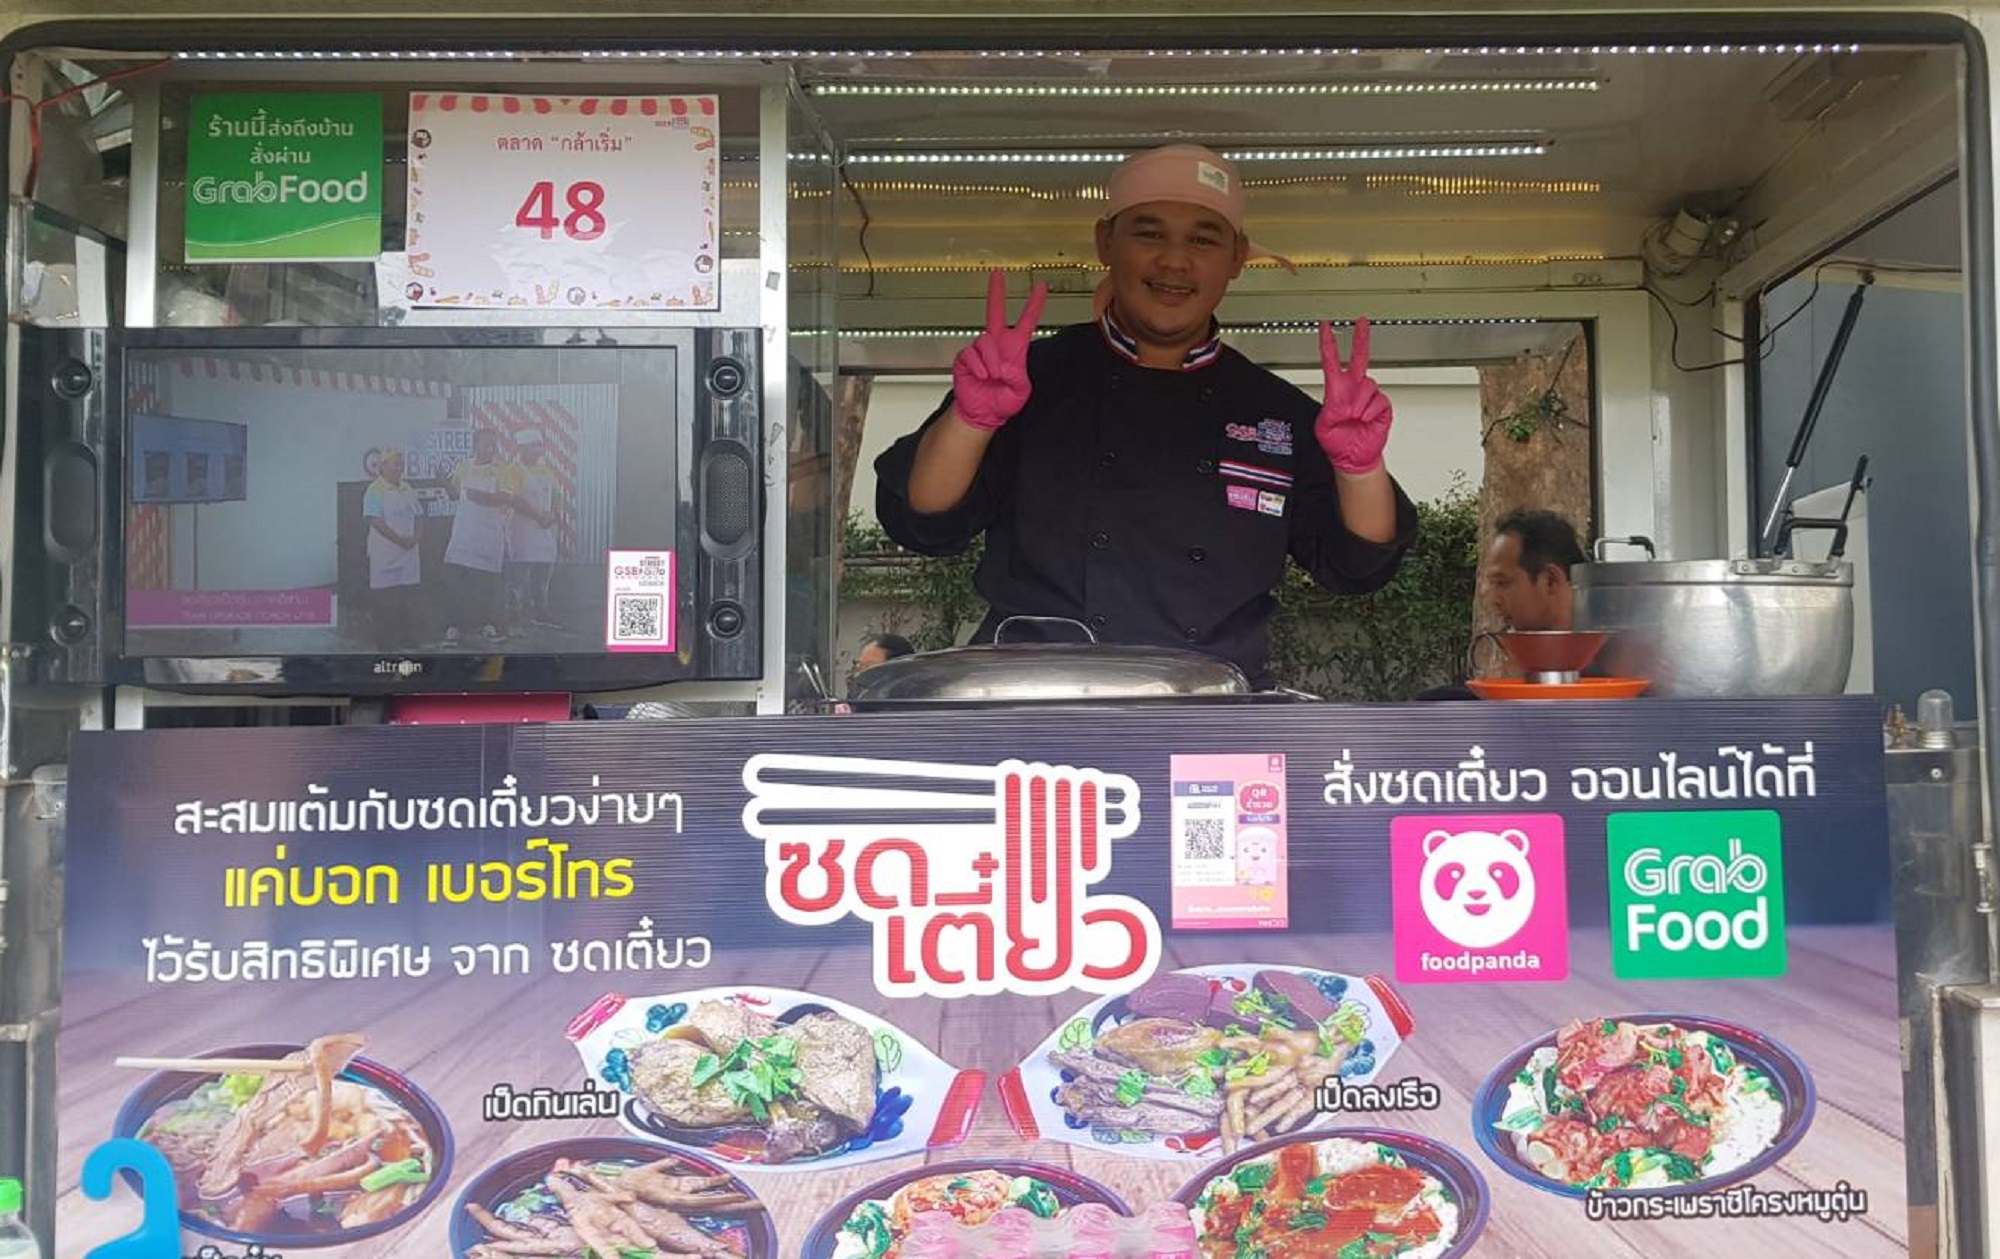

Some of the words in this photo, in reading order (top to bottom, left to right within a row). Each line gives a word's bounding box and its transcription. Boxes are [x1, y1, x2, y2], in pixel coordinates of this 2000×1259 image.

[250, 141, 311, 164] สั่งผ่าน
[497, 137, 543, 151] ตลาด
[193, 171, 368, 204] GrabFood
[515, 181, 606, 241] 48
[1571, 741, 1816, 801] ออนไลน์ได้ที่
[225, 844, 398, 907] แค่บอก
[428, 838, 634, 903] เบอร์โทร
[1624, 838, 1768, 896] Grab
[1626, 896, 1769, 952] Food
[142, 934, 431, 983] ไว้รับสิทธิพิเศษ
[451, 943, 530, 975] จาก
[1420, 950, 1541, 975] foodpanda
[485, 1079, 618, 1120] เป็ดกินเล่น
[1316, 1076, 1439, 1110] เป็ดลงเรือ
